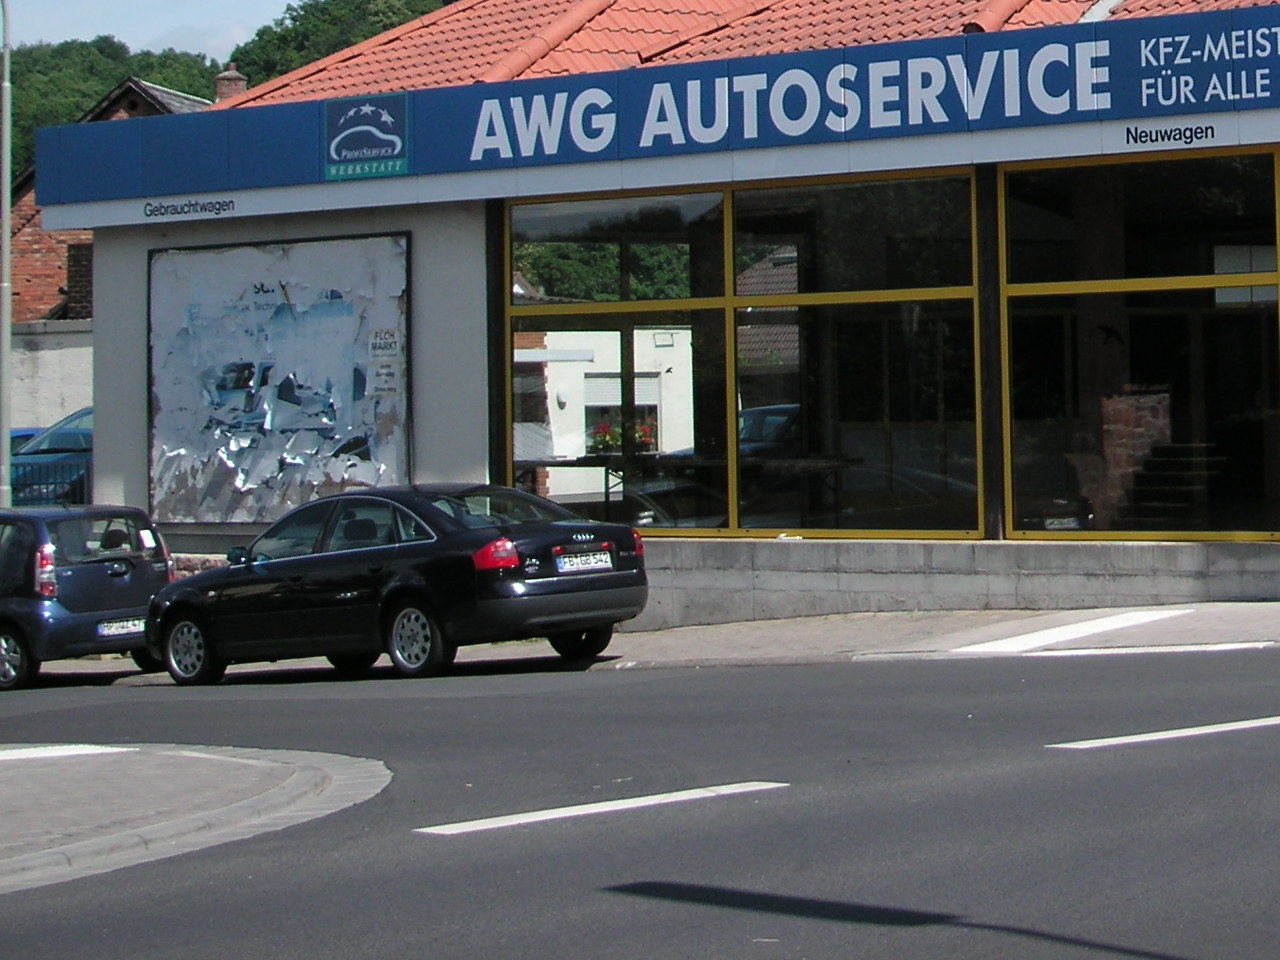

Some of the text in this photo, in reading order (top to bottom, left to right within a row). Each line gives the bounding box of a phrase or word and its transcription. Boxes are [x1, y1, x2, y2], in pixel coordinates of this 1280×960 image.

[1141, 69, 1197, 107] FÜR
[1204, 67, 1271, 102] ALLE
[470, 40, 1112, 161] AWG AUTOSERVICE
[1126, 125, 1215, 145] Neuwagen
[330, 160, 402, 176] WERKSTATT
[143, 199, 235, 217] Gebrauchtwagen
[371, 341, 397, 351] MARKT
